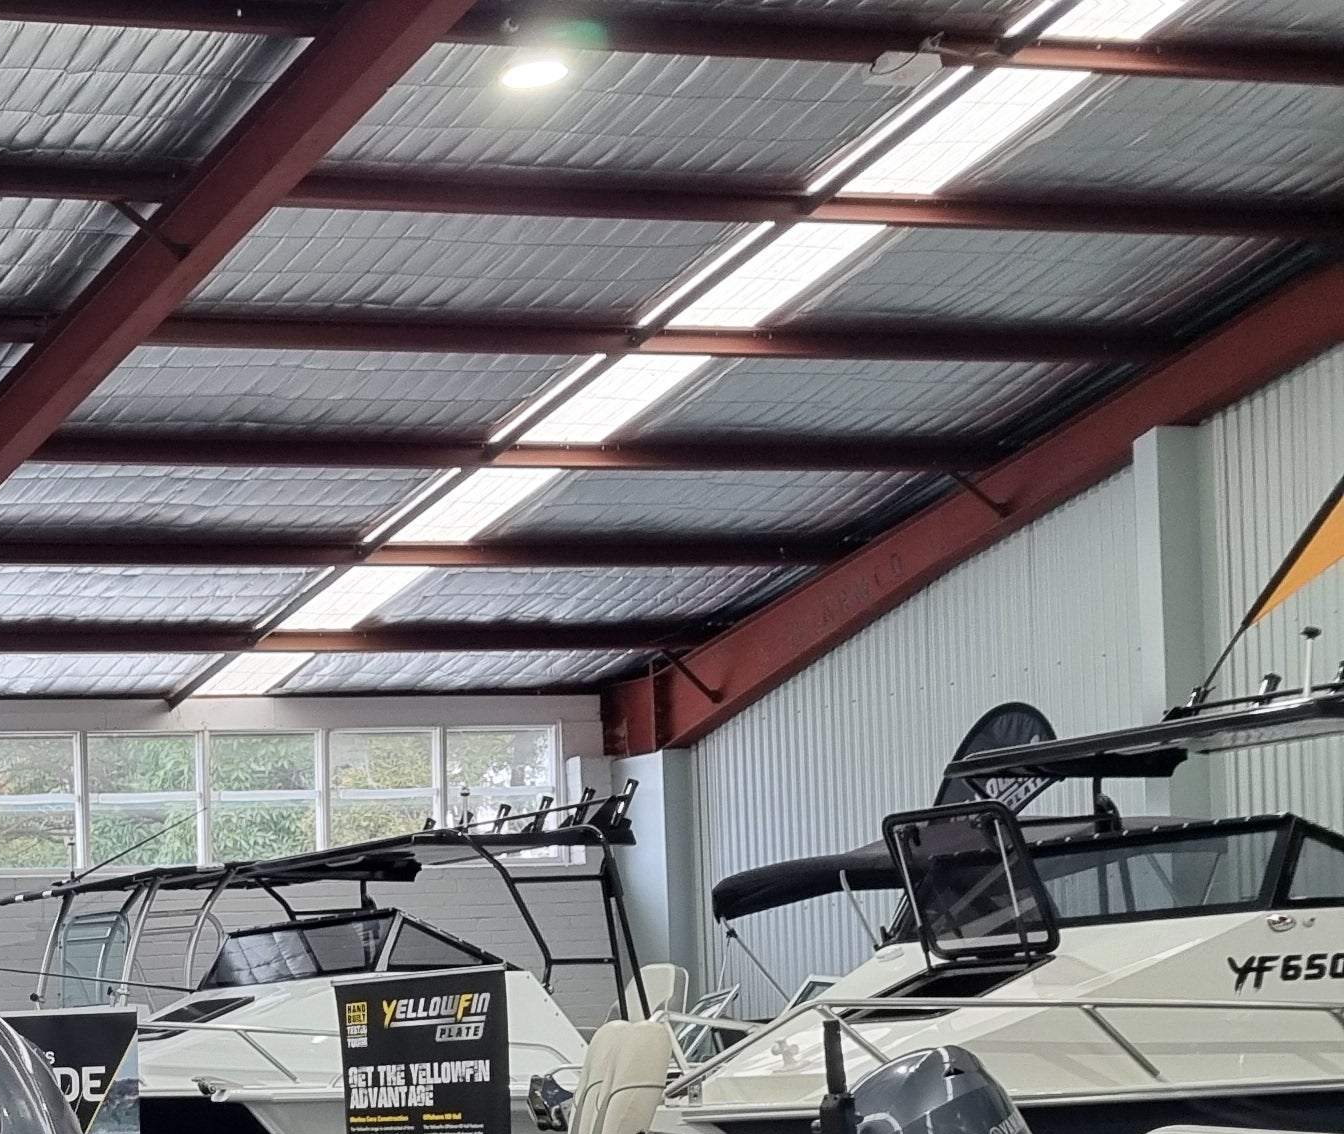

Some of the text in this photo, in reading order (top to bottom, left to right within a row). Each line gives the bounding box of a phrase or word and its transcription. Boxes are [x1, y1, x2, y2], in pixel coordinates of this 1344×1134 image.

[439, 1025, 481, 1039] PLATE
[348, 1059, 491, 1088] GET THE YELLOWFIN
[349, 1084, 434, 1110] ADVANTAGE
